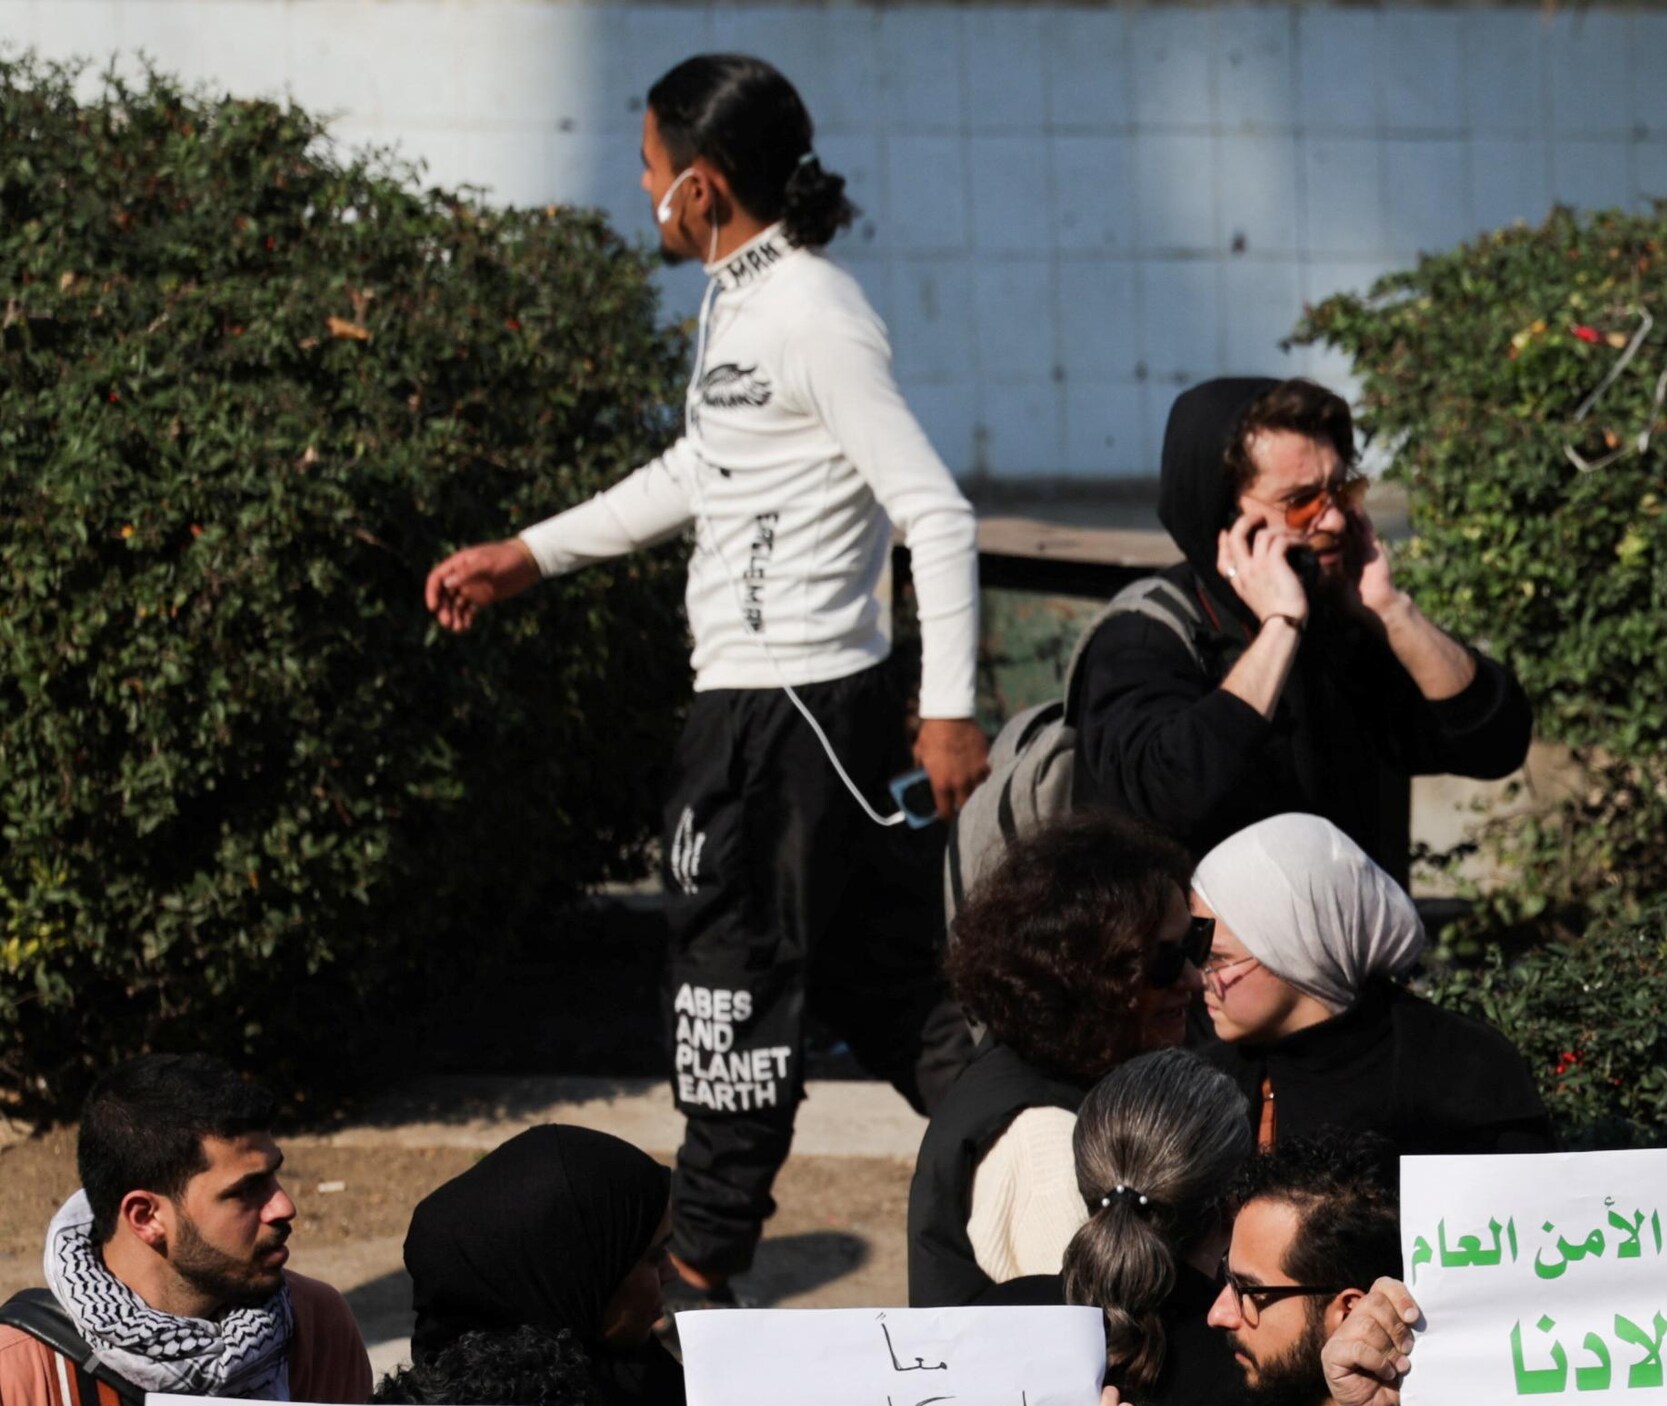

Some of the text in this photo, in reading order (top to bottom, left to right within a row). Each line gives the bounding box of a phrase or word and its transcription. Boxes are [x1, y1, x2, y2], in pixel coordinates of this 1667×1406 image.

[674, 983, 753, 1022] ABES
[675, 1014, 734, 1053] AND
[675, 1045, 791, 1083] PLANET
[677, 1072, 777, 1112] EARTH
[1409, 1215, 1519, 1286] العام
[1533, 1195, 1663, 1280] الأمن
